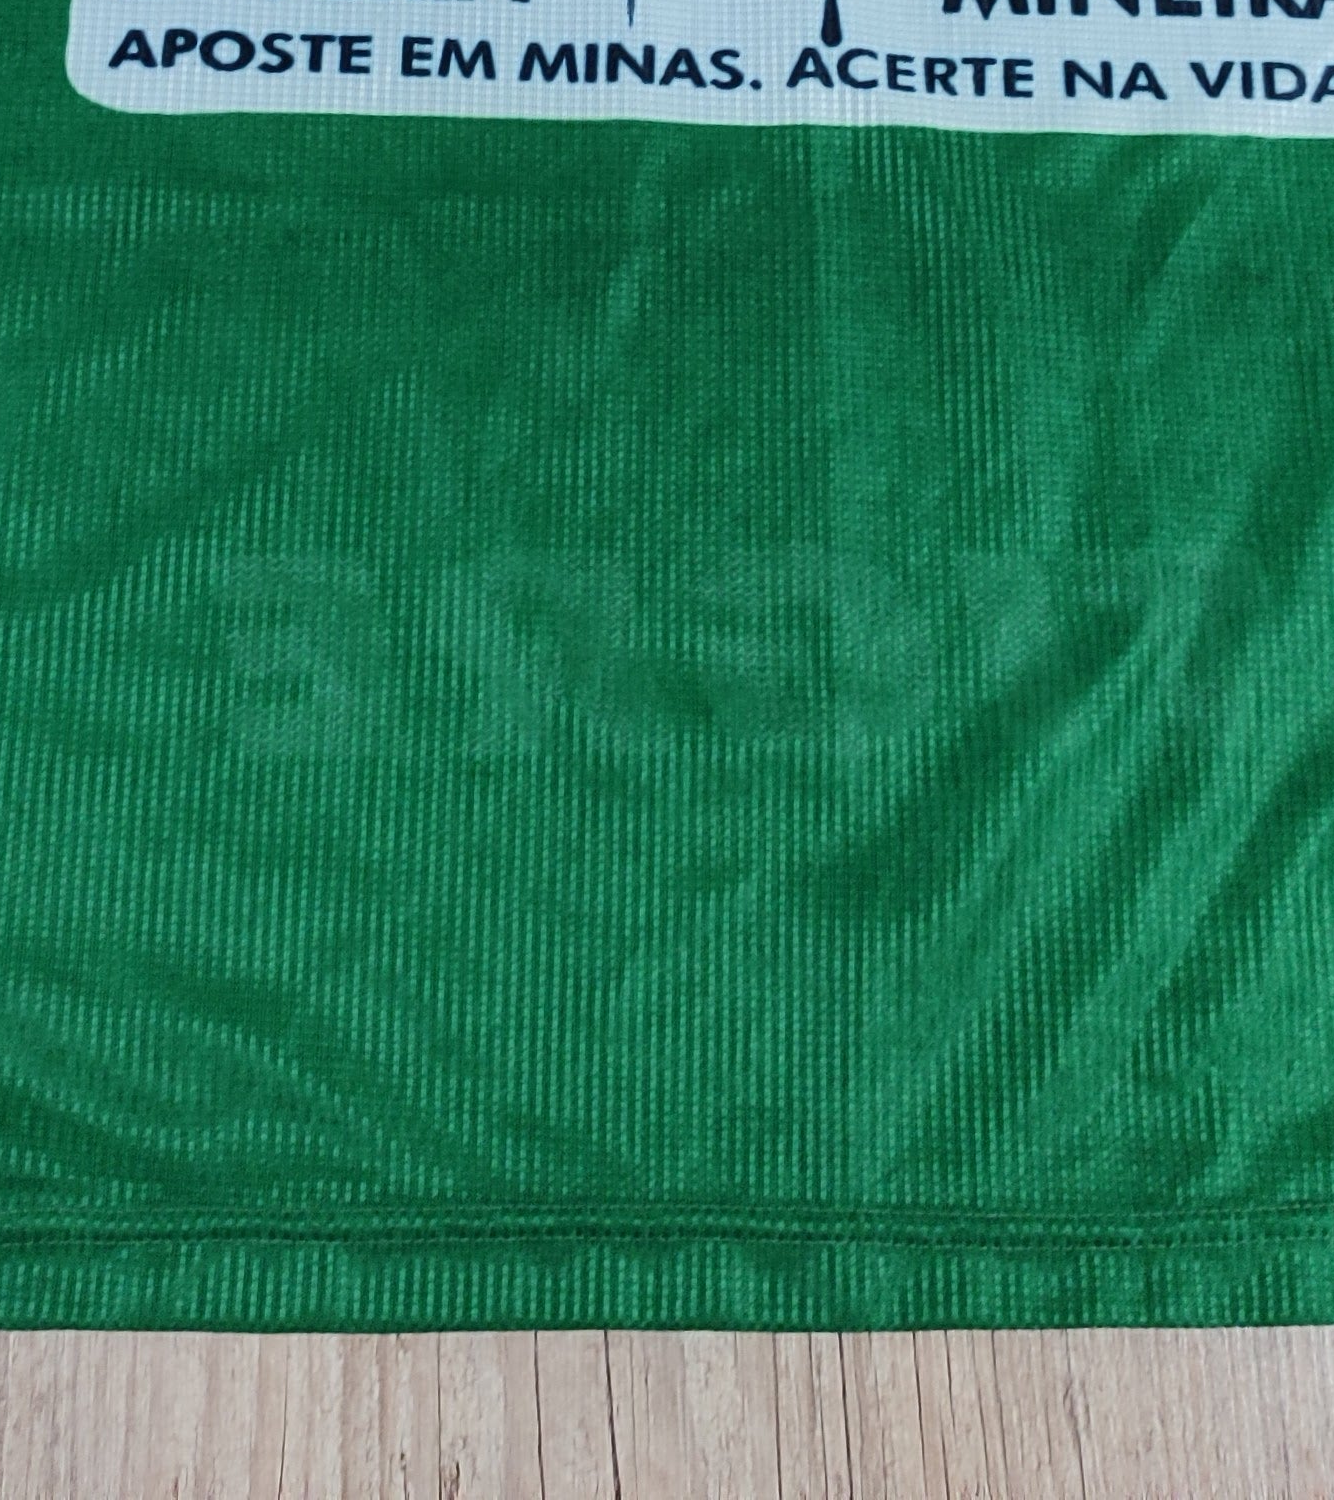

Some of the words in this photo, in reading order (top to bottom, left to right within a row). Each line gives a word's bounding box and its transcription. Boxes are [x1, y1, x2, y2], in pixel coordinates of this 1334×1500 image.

[108, 28, 373, 74] APOSTE
[400, 36, 497, 79] EM
[518, 42, 763, 90] MINAS.
[786, 47, 1035, 98] ACERTE
[1064, 60, 1168, 100] NA
